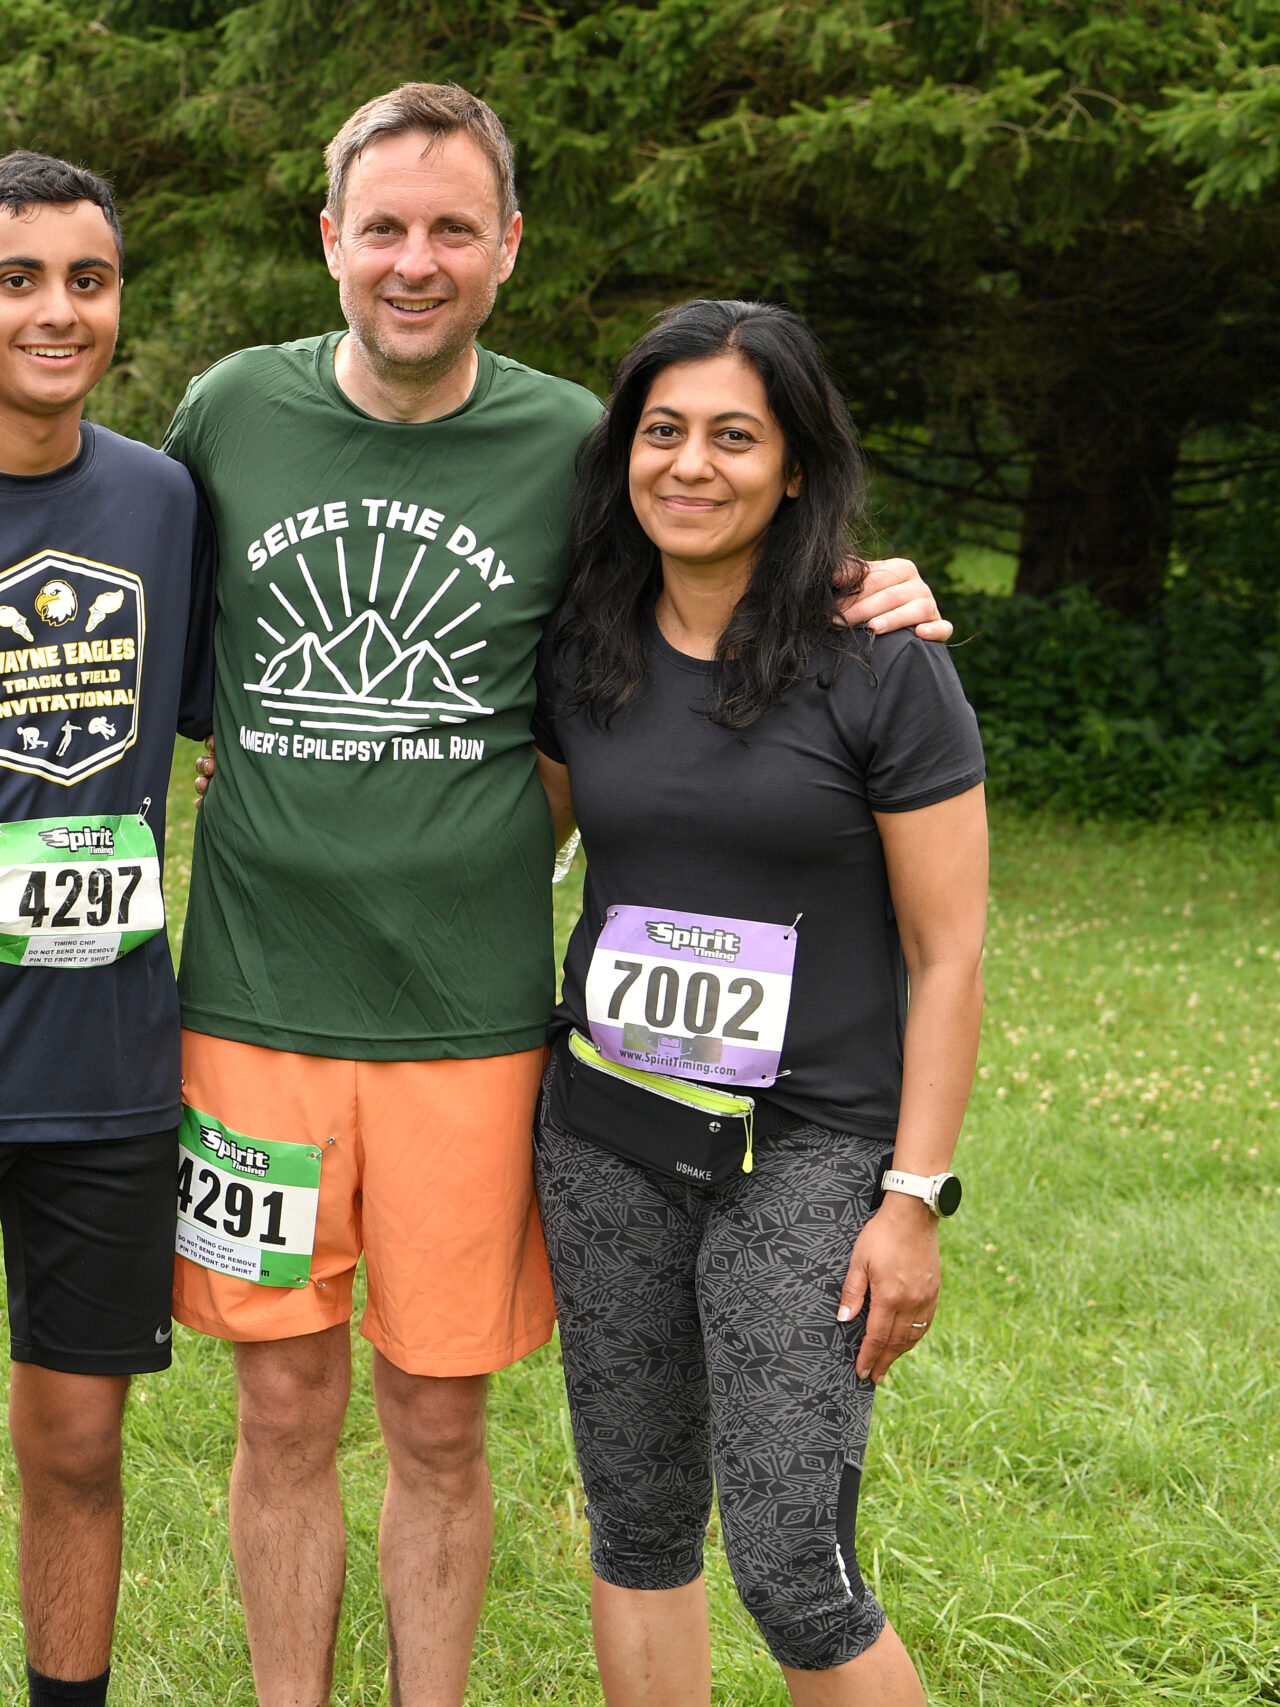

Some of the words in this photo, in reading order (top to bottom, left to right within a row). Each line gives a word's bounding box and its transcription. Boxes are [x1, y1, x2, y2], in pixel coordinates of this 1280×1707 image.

[247, 501, 349, 572] SEIZE
[361, 498, 446, 541] THE
[445, 524, 515, 591] DAY
[63, 637, 135, 666] EAGLES
[2, 673, 63, 694] TRACK
[64, 673, 78, 687] &
[80, 669, 121, 685] FIELD
[239, 726, 288, 757] AMER'S
[292, 734, 386, 762] EPILEPSY
[391, 736, 445, 761] TRAIL
[449, 735, 485, 761] RUN
[39, 827, 114, 852] Spirit
[88, 846, 114, 855] Timing
[19, 865, 143, 928] 4297
[646, 922, 740, 951] Spirit
[693, 947, 736, 963] Timing
[607, 960, 764, 1042] 7002
[620, 1048, 737, 1077] www.SpiritTiming.com
[201, 1125, 269, 1169] Spirit
[232, 1160, 266, 1177] Timing
[676, 1161, 713, 1181] USHAKE
[177, 1156, 286, 1246] 4291
[178, 1234, 186, 1242] DO
[187, 1238, 198, 1248] NOT
[216, 1252, 226, 1260] OR
[227, 1255, 257, 1268] REMOVE
[196, 1235, 217, 1248] TIMING
[217, 1244, 234, 1253] CHIP
[180, 1244, 189, 1253] PIN
[190, 1249, 198, 1258] TO
[198, 1254, 219, 1266] FRONT
[231, 1266, 253, 1276] SHIRT
